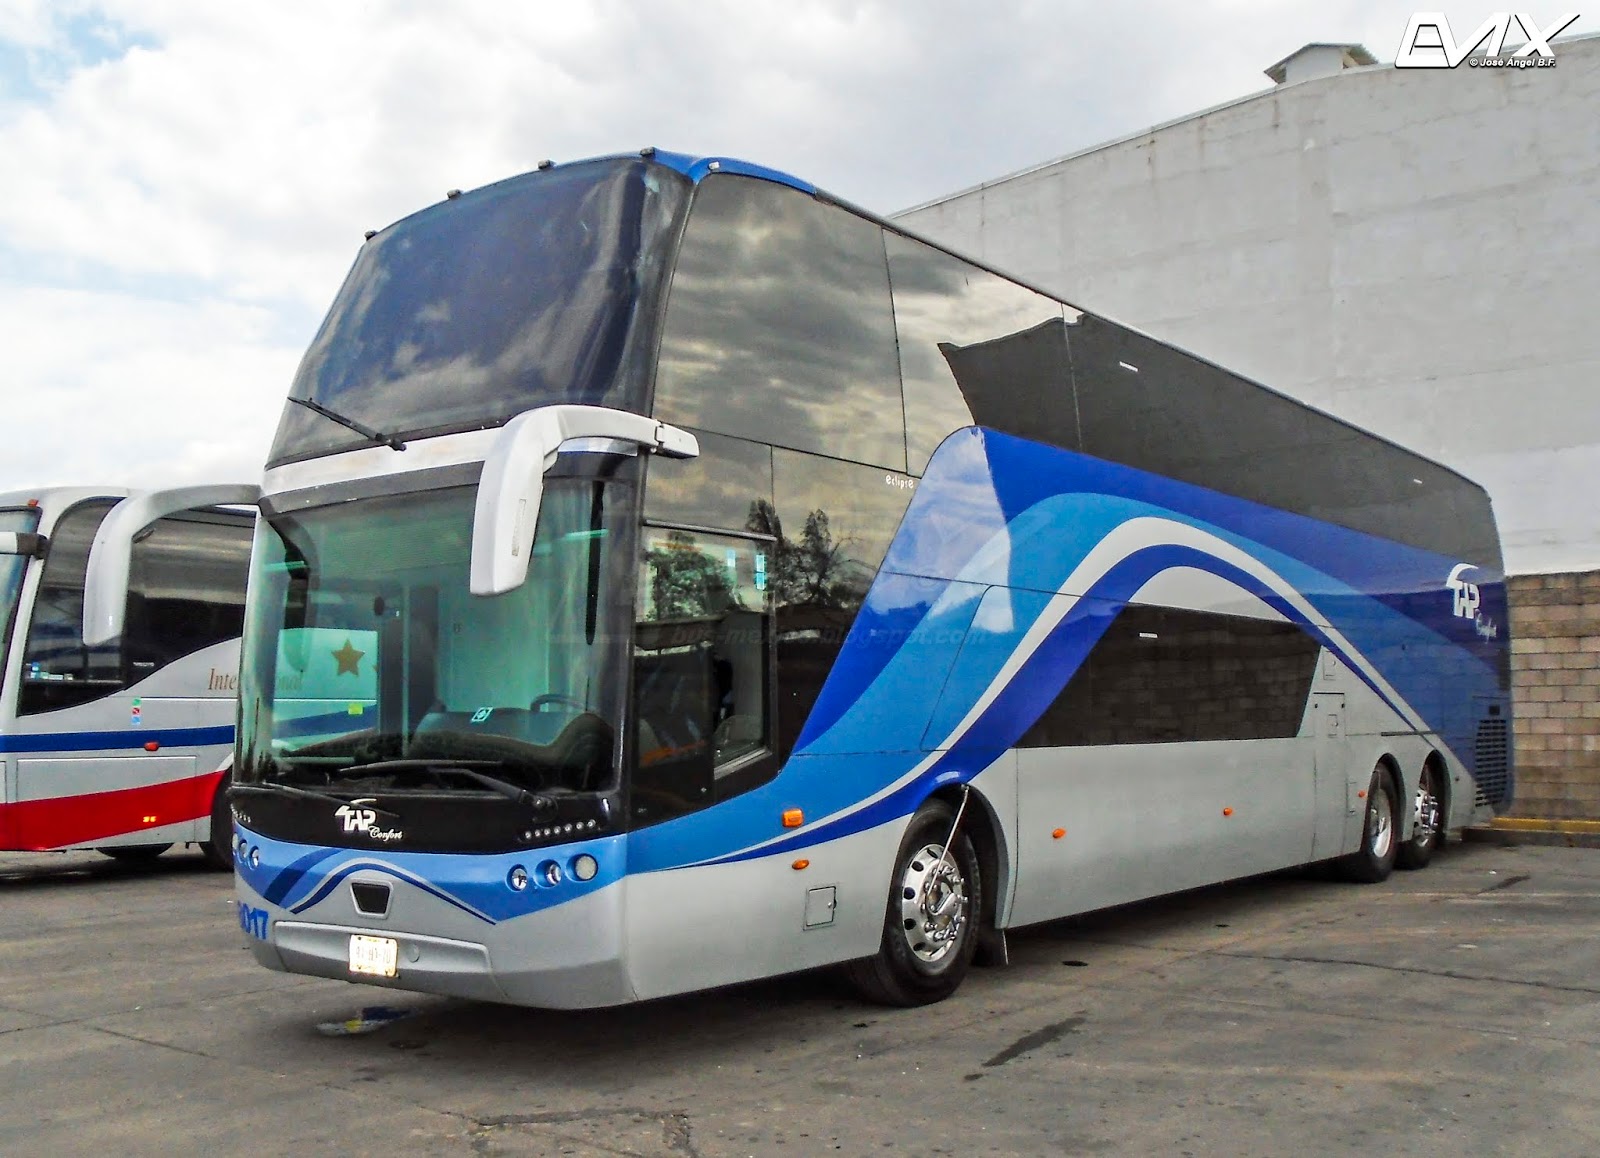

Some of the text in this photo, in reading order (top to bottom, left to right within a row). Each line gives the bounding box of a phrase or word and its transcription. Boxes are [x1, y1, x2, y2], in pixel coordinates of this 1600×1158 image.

[1446, 563, 1479, 619] TAP
[335, 804, 376, 831] TAP
[368, 826, 402, 841] Confort
